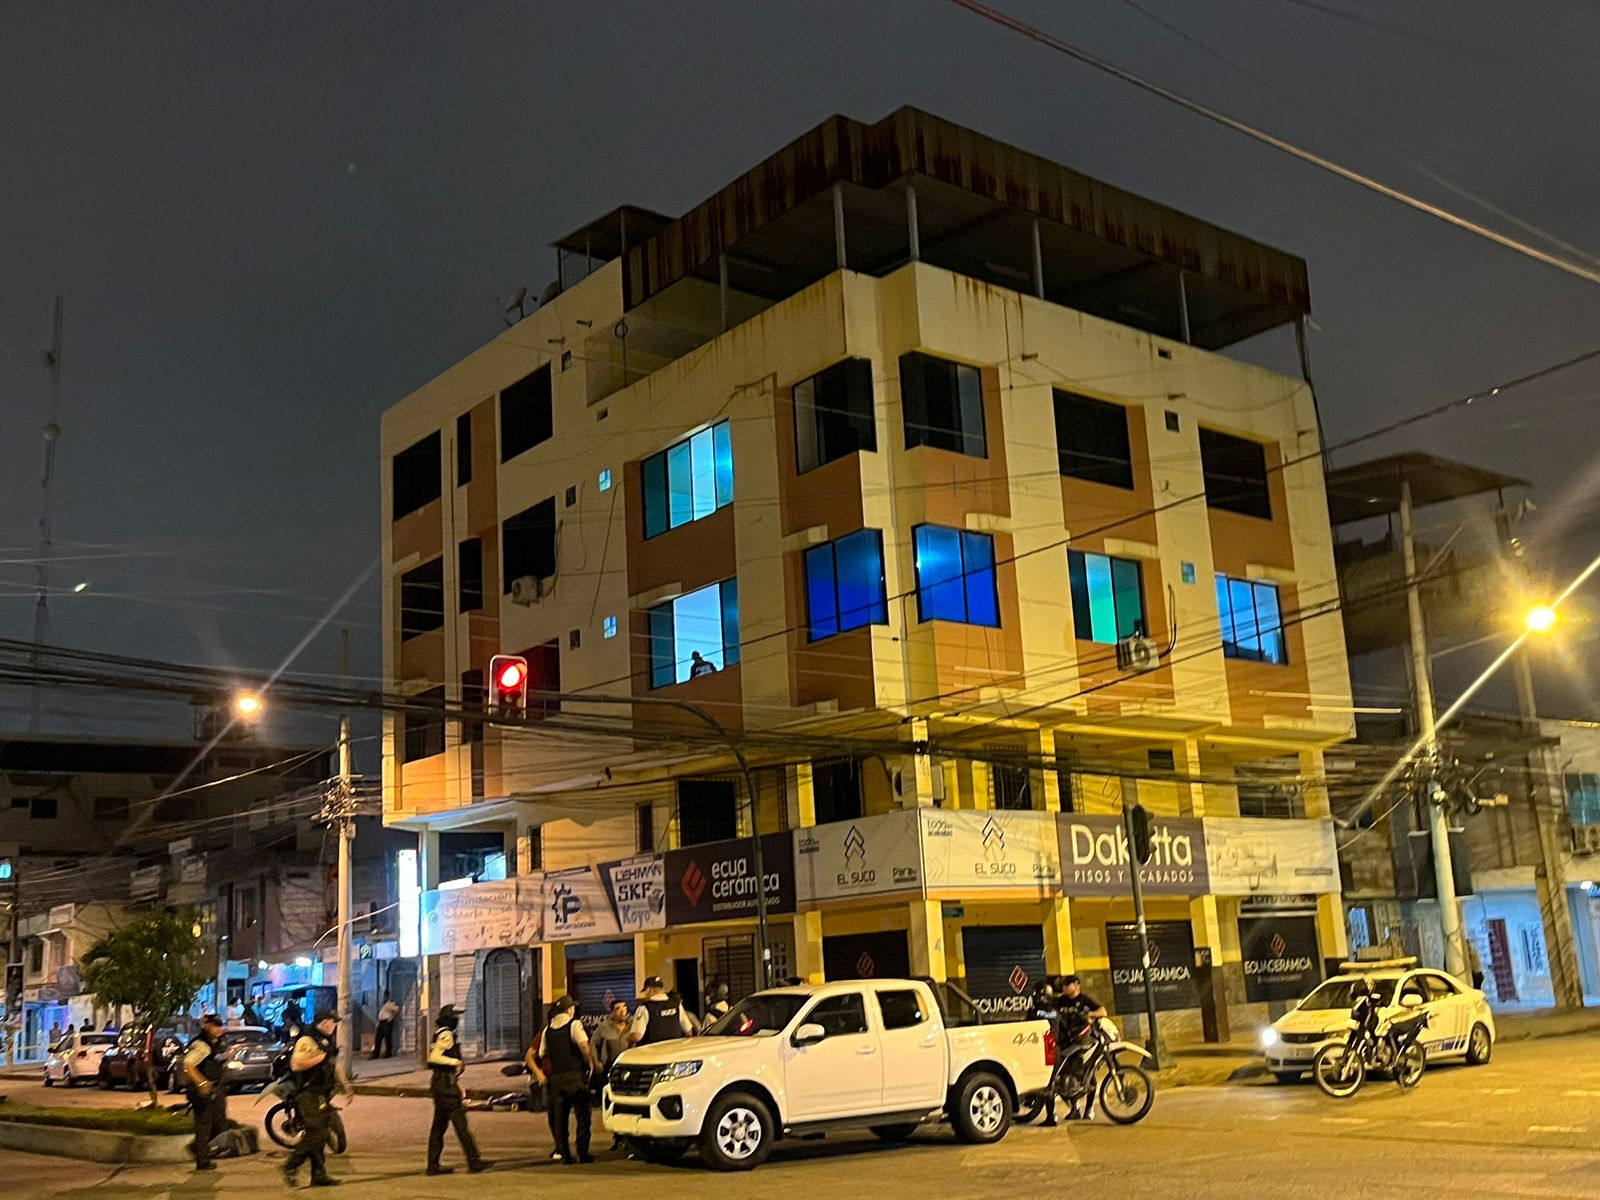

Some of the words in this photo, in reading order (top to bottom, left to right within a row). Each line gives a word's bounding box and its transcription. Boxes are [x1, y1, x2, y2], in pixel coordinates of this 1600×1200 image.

[1070, 824, 1193, 867] Daktta
[711, 858, 747, 879] ecua
[837, 873, 848, 886] EL
[851, 869, 876, 885] SUCO
[975, 863, 987, 875] EL
[990, 863, 1016, 875] SUCO
[1074, 869, 1111, 883] PISOS
[1117, 869, 1124, 883] Y
[1133, 869, 1194, 883] CABADOS
[618, 882, 653, 902] SKF
[712, 872, 780, 898] cerámca
[622, 905, 650, 929] Koyo
[1113, 965, 1191, 985] ECUAERAMICA
